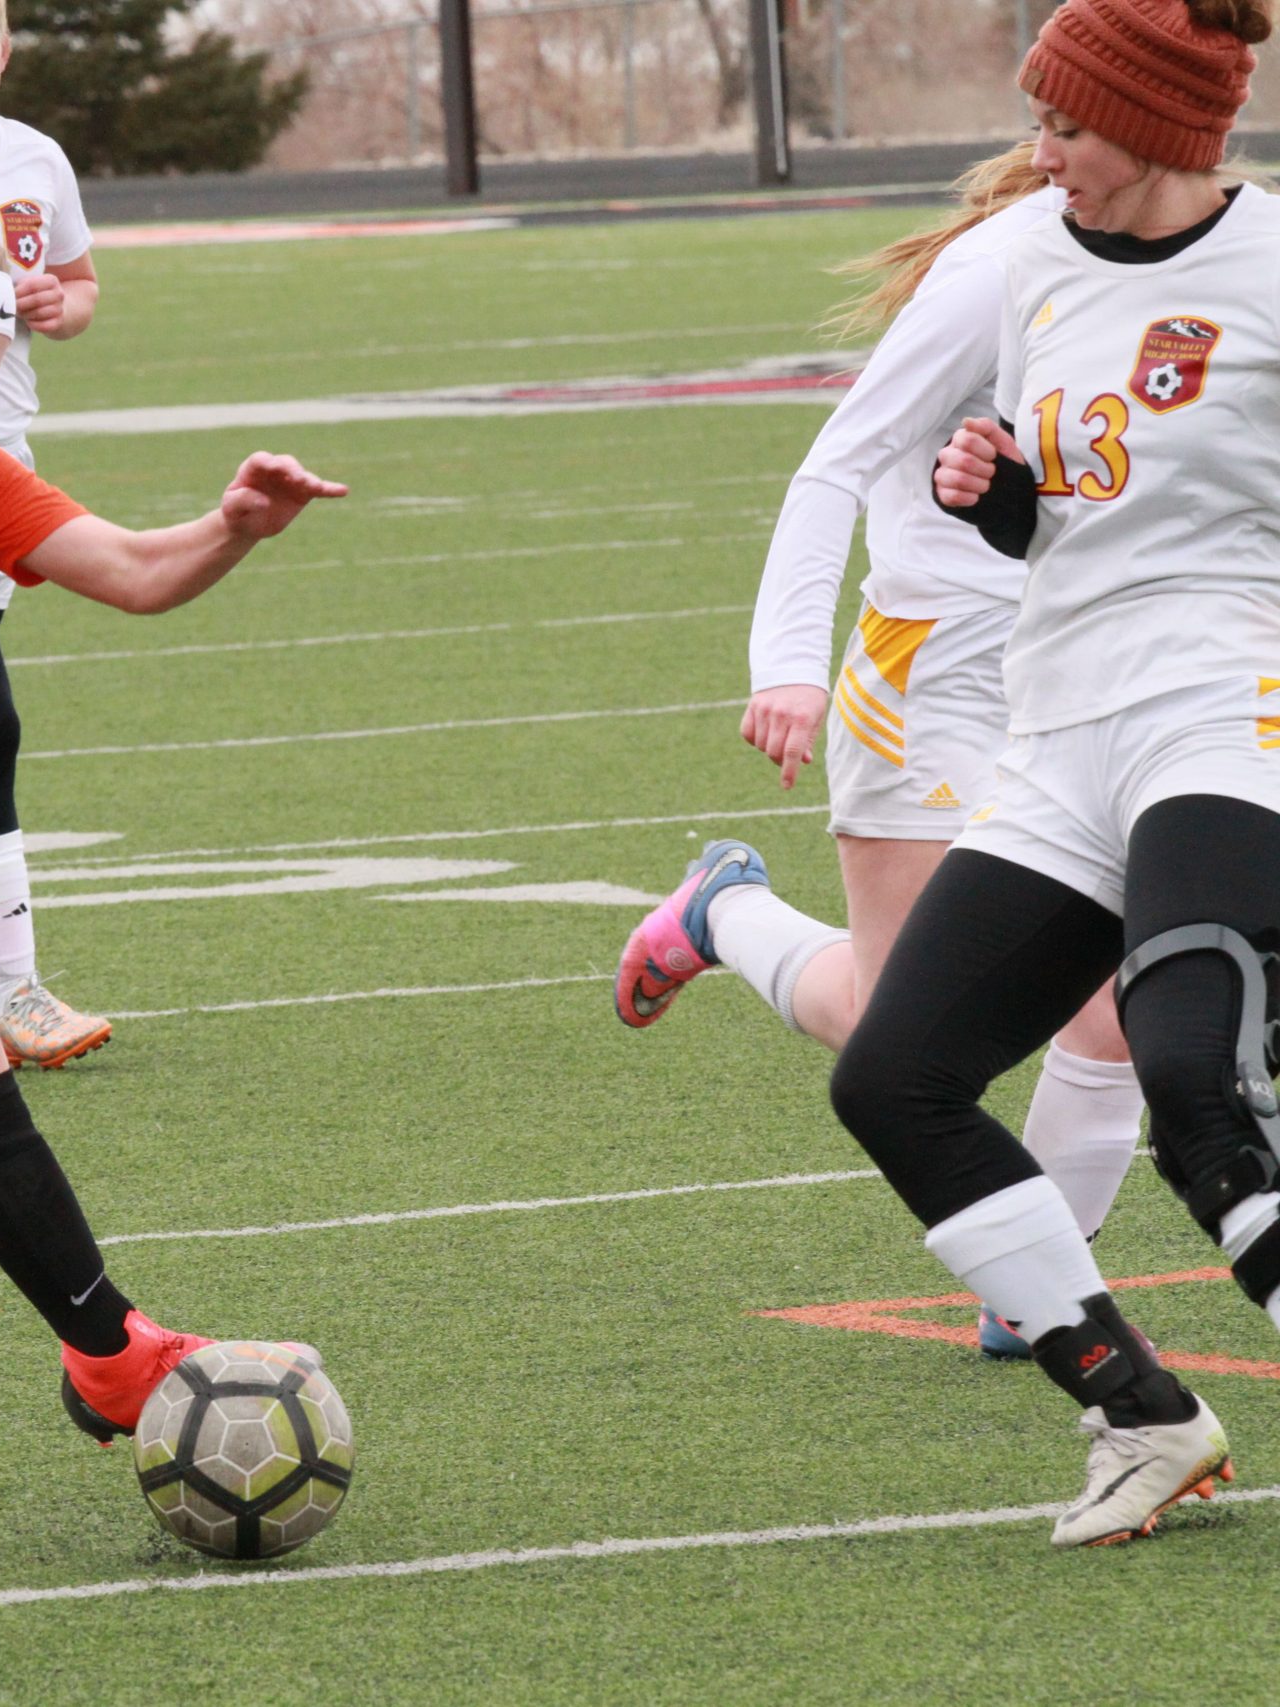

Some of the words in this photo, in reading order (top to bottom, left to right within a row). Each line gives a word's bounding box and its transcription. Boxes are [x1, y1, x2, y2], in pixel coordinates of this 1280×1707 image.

[1149, 338, 1173, 349] STAR
[1174, 341, 1206, 351] VALLEY
[1032, 387, 1130, 502] 13
